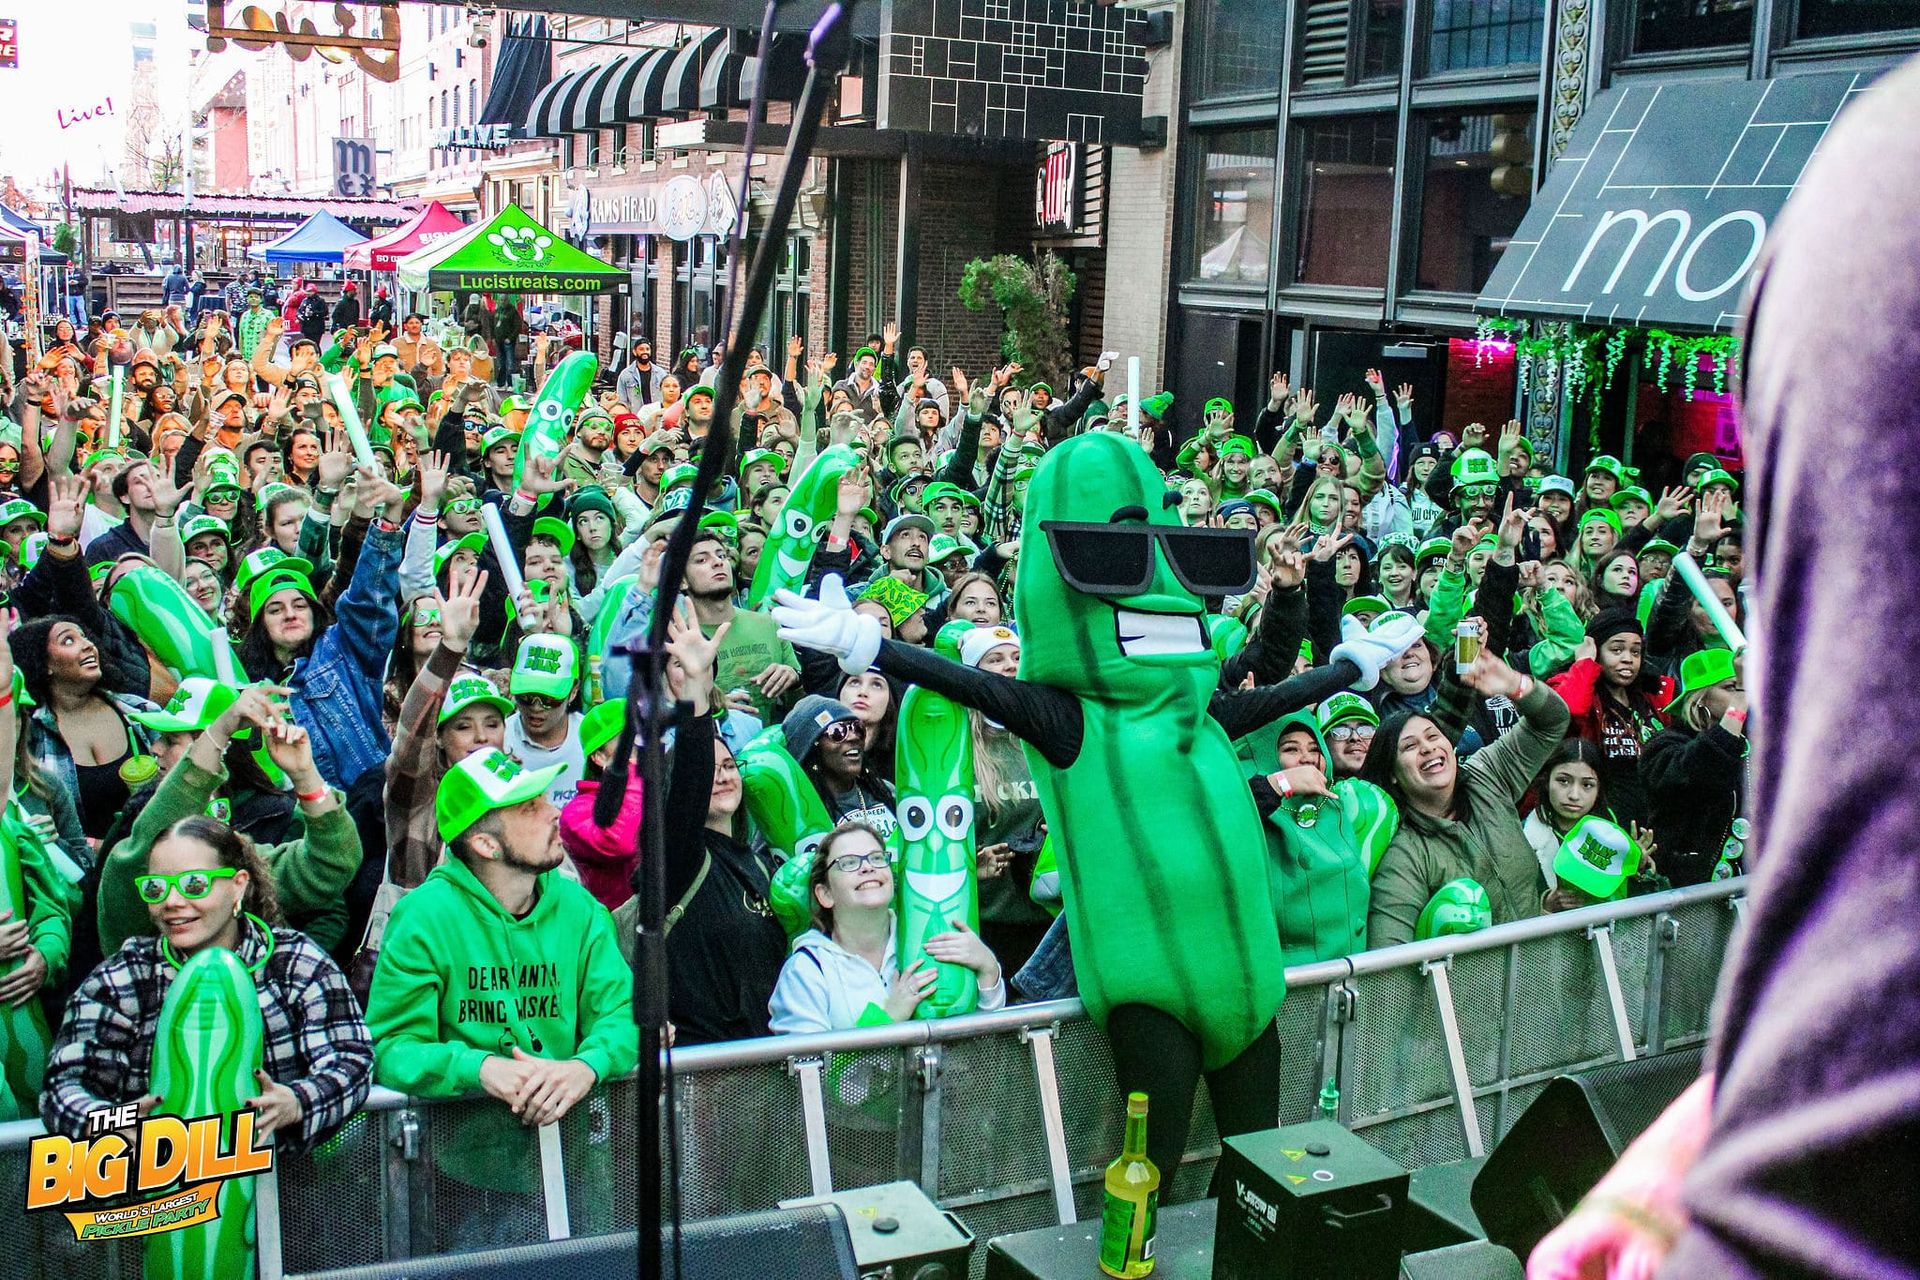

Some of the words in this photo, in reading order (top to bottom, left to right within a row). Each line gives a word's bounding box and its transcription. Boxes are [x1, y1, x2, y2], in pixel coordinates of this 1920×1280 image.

[57, 97, 115, 129] Live!
[591, 198, 620, 224] RAMS
[621, 195, 656, 223] HEAD
[1561, 208, 1767, 302] mo
[459, 273, 601, 291] Lucistreats.com
[468, 966, 510, 991] DEAR
